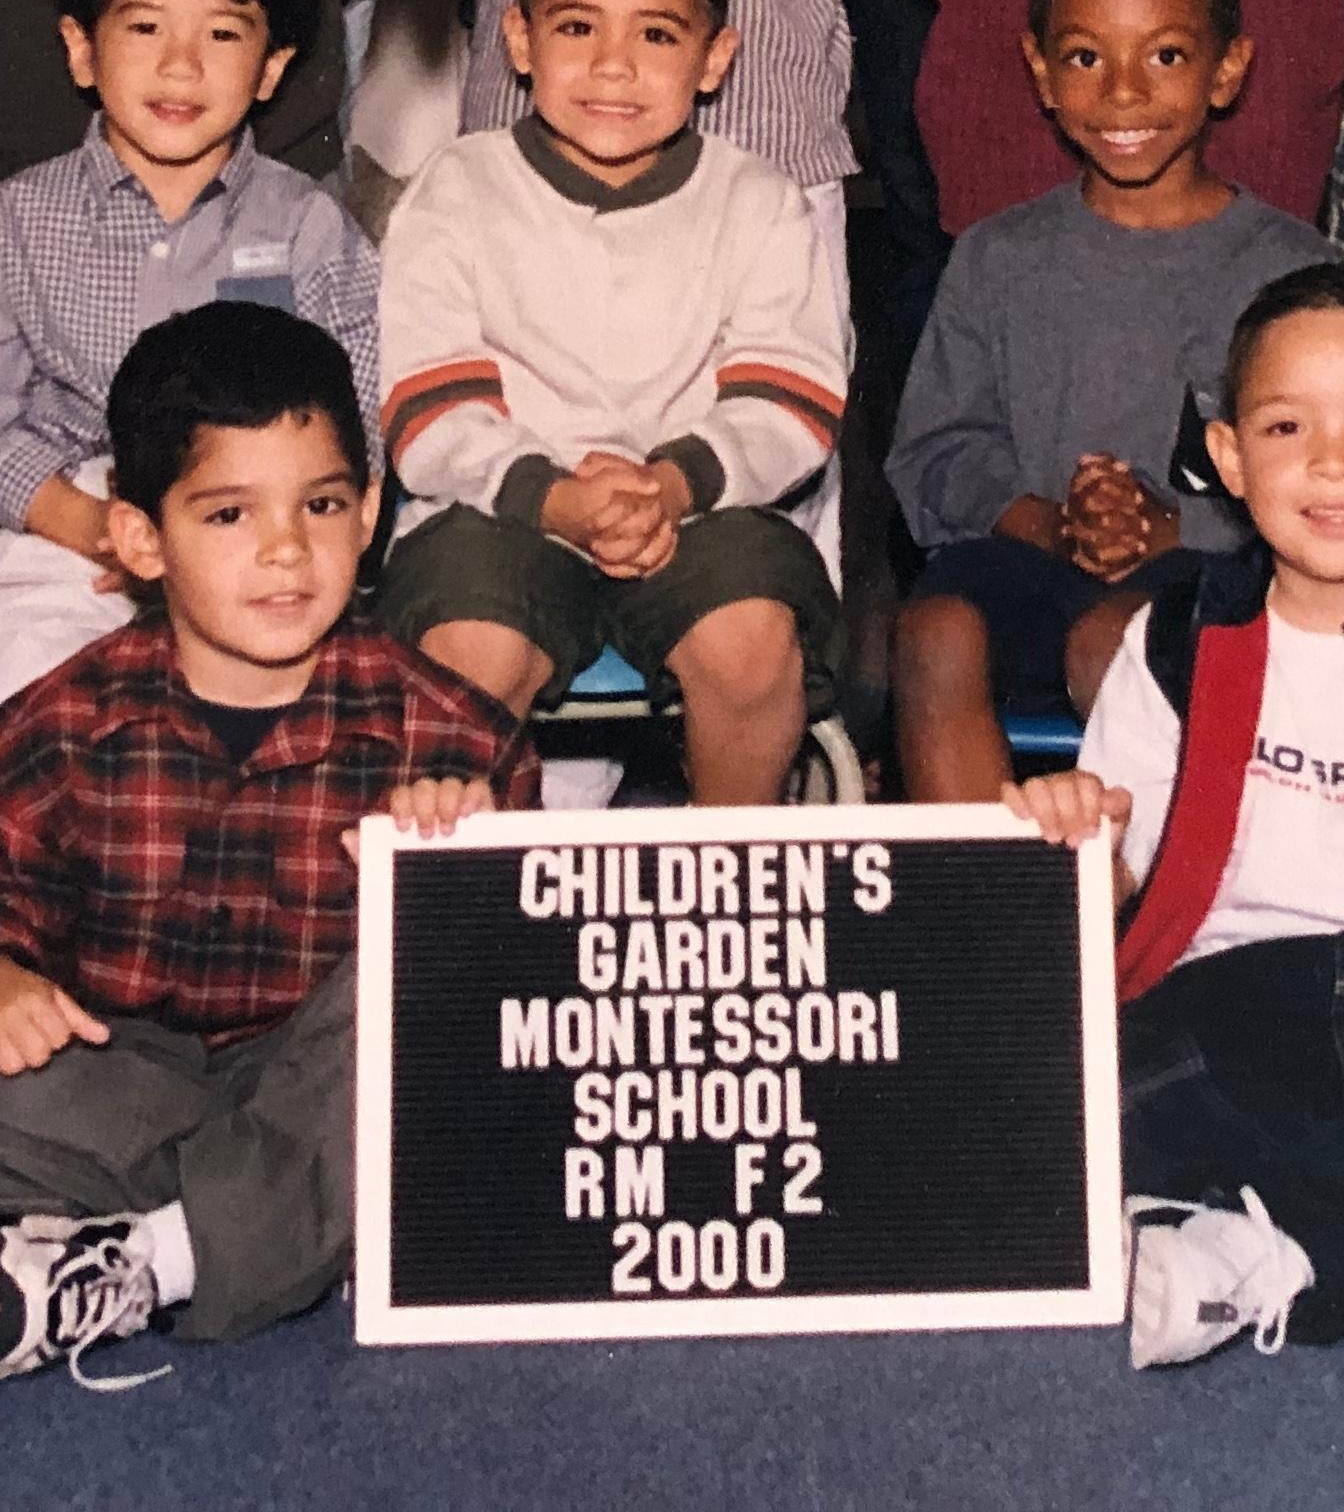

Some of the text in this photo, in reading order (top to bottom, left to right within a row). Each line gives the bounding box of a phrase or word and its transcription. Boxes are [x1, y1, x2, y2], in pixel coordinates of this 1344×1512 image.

[520, 842, 892, 919] CHILDREN'S
[577, 919, 827, 991] GARDEN
[500, 991, 900, 1069] MONTESSORI
[573, 1068, 817, 1142] SCHOOL
[564, 1146, 666, 1219] RM
[611, 1217, 786, 1294] 2000
